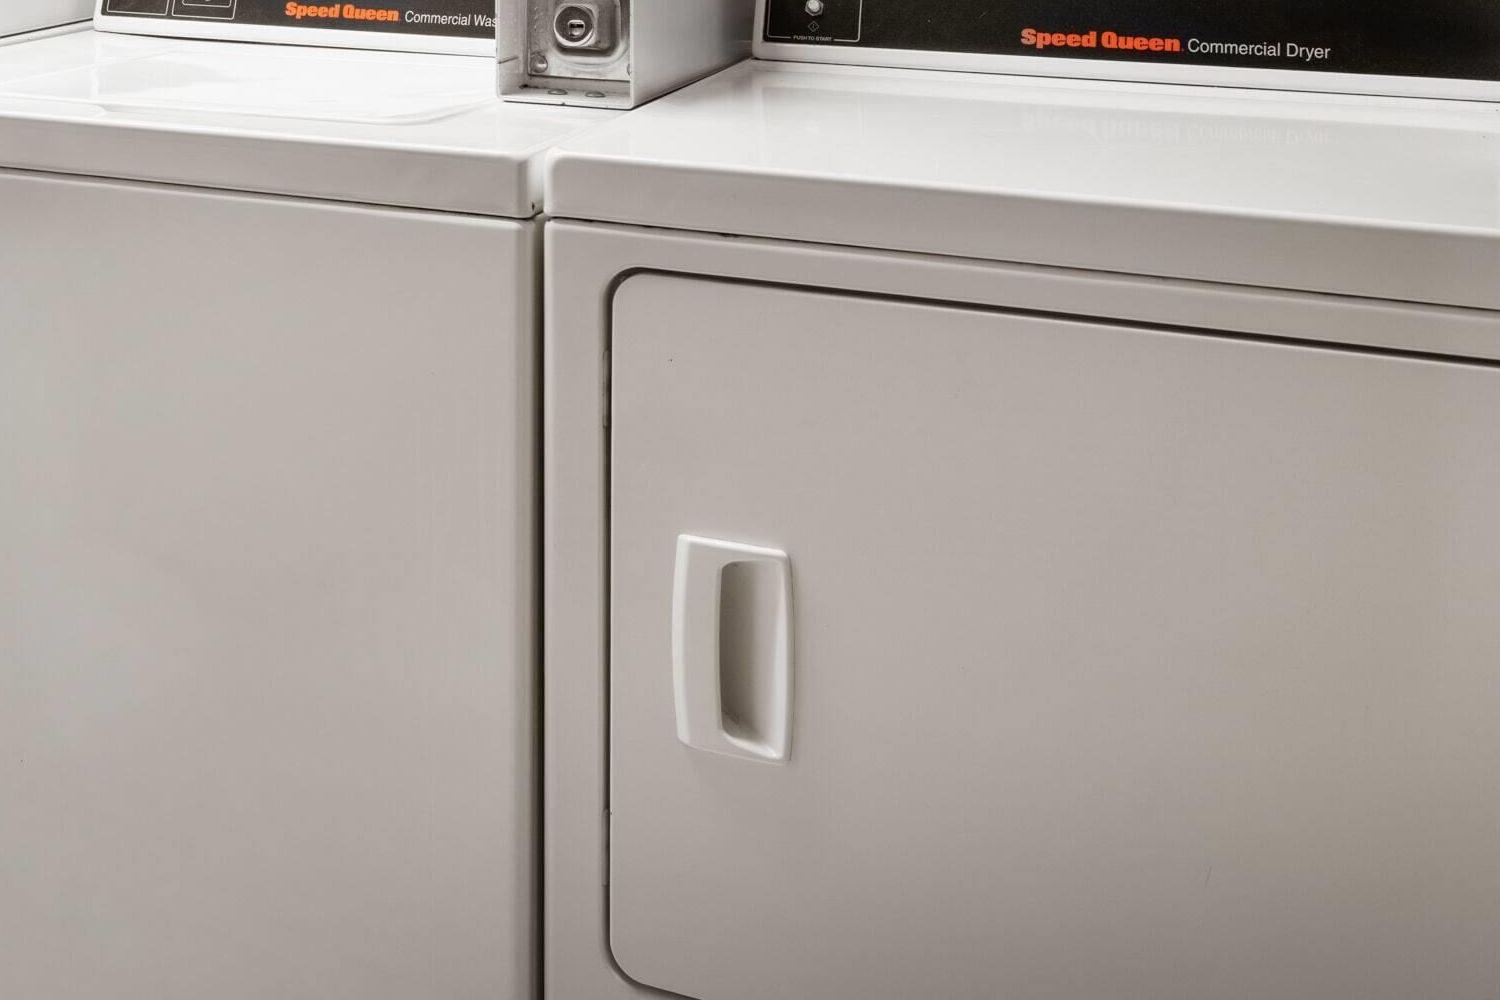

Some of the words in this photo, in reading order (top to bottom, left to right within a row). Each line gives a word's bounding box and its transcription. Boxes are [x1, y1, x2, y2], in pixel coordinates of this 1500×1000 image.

[285, 1, 341, 19] Speed
[342, 3, 399, 22] Queen
[404, 10, 472, 26] Commercial
[1020, 27, 1097, 49] Speed
[1101, 31, 1182, 52] Queen
[1187, 38, 1281, 57] Commercial
[1286, 42, 1331, 62] Dryer
